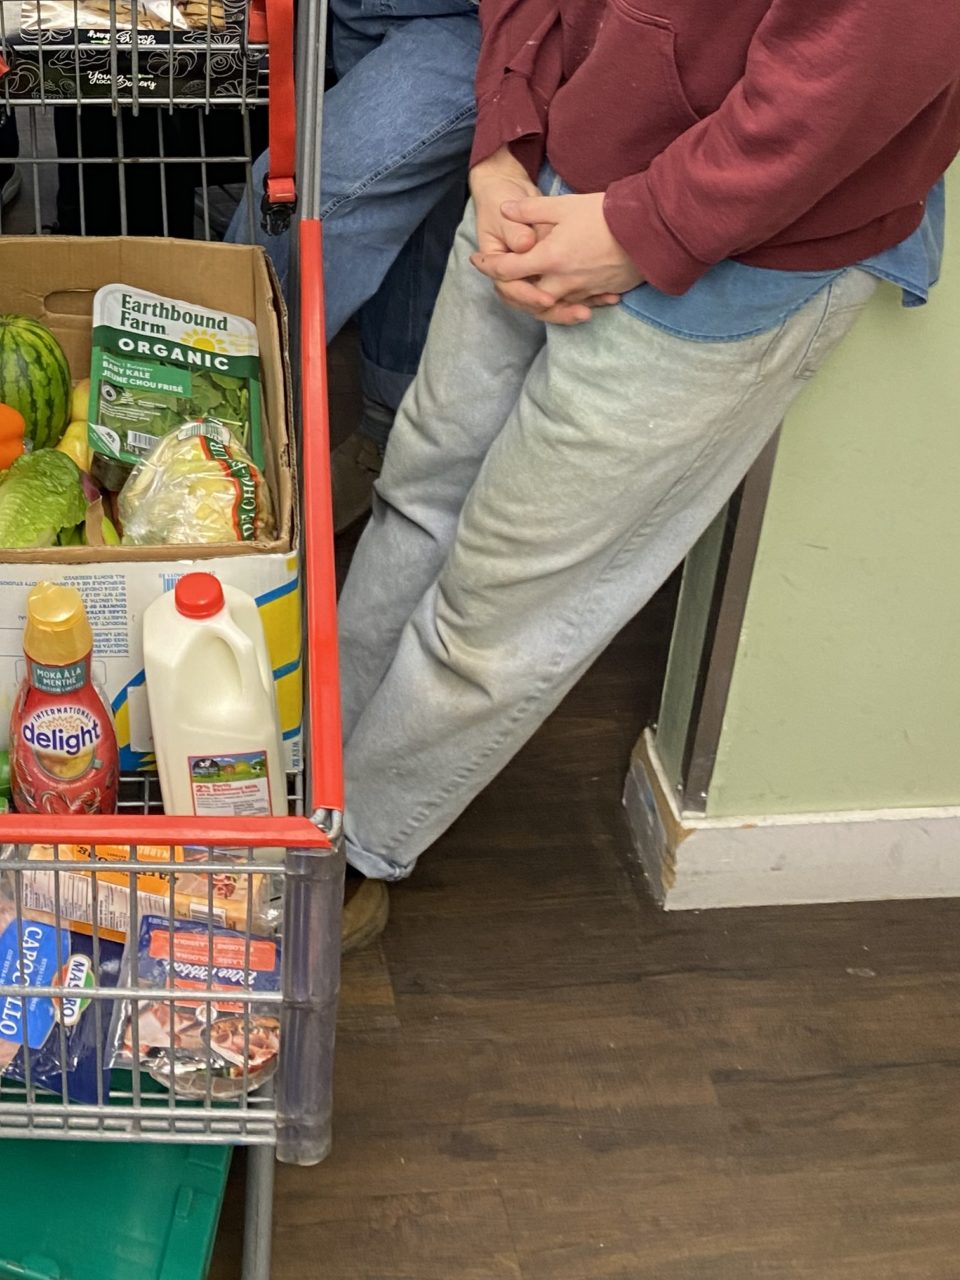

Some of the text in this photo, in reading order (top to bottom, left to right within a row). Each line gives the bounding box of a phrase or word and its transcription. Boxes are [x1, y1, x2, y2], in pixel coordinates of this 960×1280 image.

[120, 310, 167, 335] Farm
[121, 293, 228, 332] Earthbound
[118, 337, 230, 371] ORGANIC
[102, 360, 150, 379] BABY KALE
[102, 369, 184, 393] JEUNE CHOU FRISÉ
[241, 513, 255, 537] DE
[36, 668, 62, 678] MOKA
[71, 667, 82, 676] LA
[43, 676, 77, 687] MENTHE
[33, 706, 93, 723] INTERNATIONAL
[23, 720, 101, 756] delight
[63, 960, 86, 1017] MASRO
[218, 968, 257, 986] Blue
